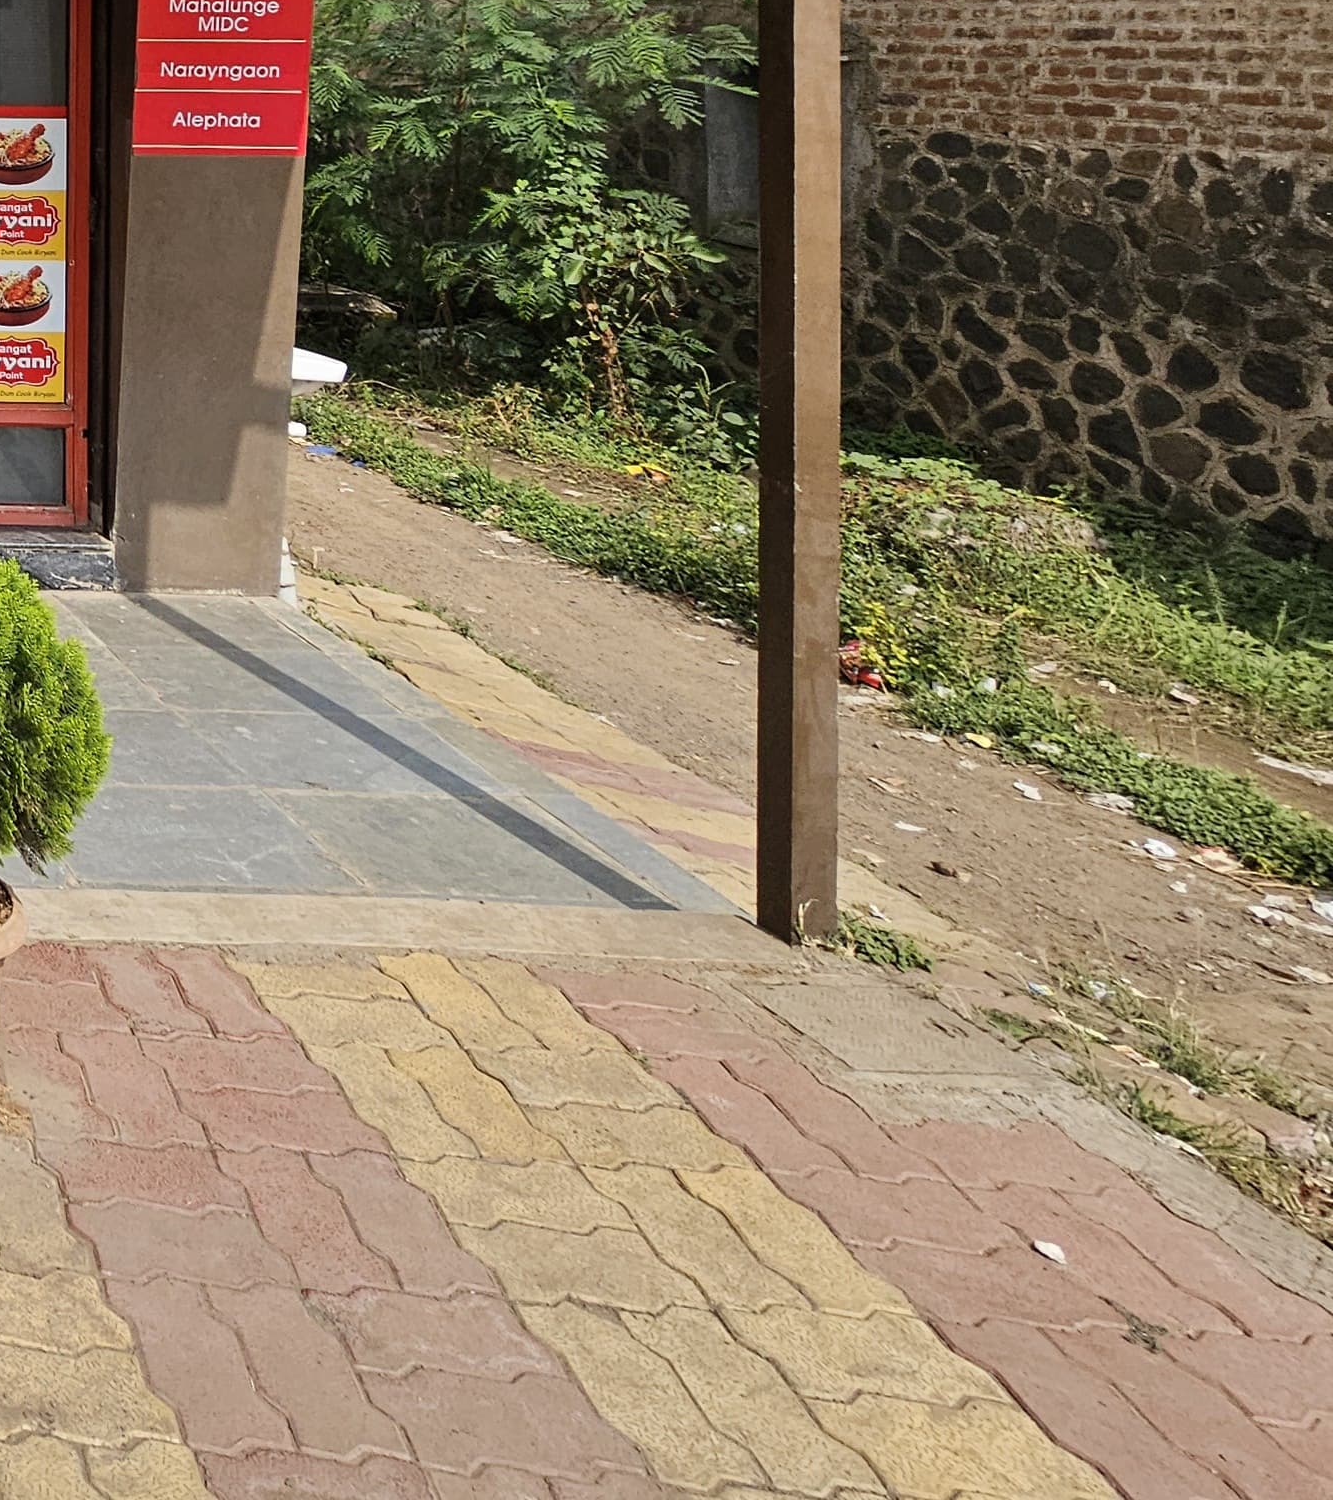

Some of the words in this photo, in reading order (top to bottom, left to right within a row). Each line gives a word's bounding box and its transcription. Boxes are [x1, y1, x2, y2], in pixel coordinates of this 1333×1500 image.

[197, 16, 249, 32] MIDC
[160, 62, 280, 81] Narayngaon
[172, 111, 261, 130] Alephata
[0, 230, 25, 238] Point
[0, 372, 23, 380] Point
